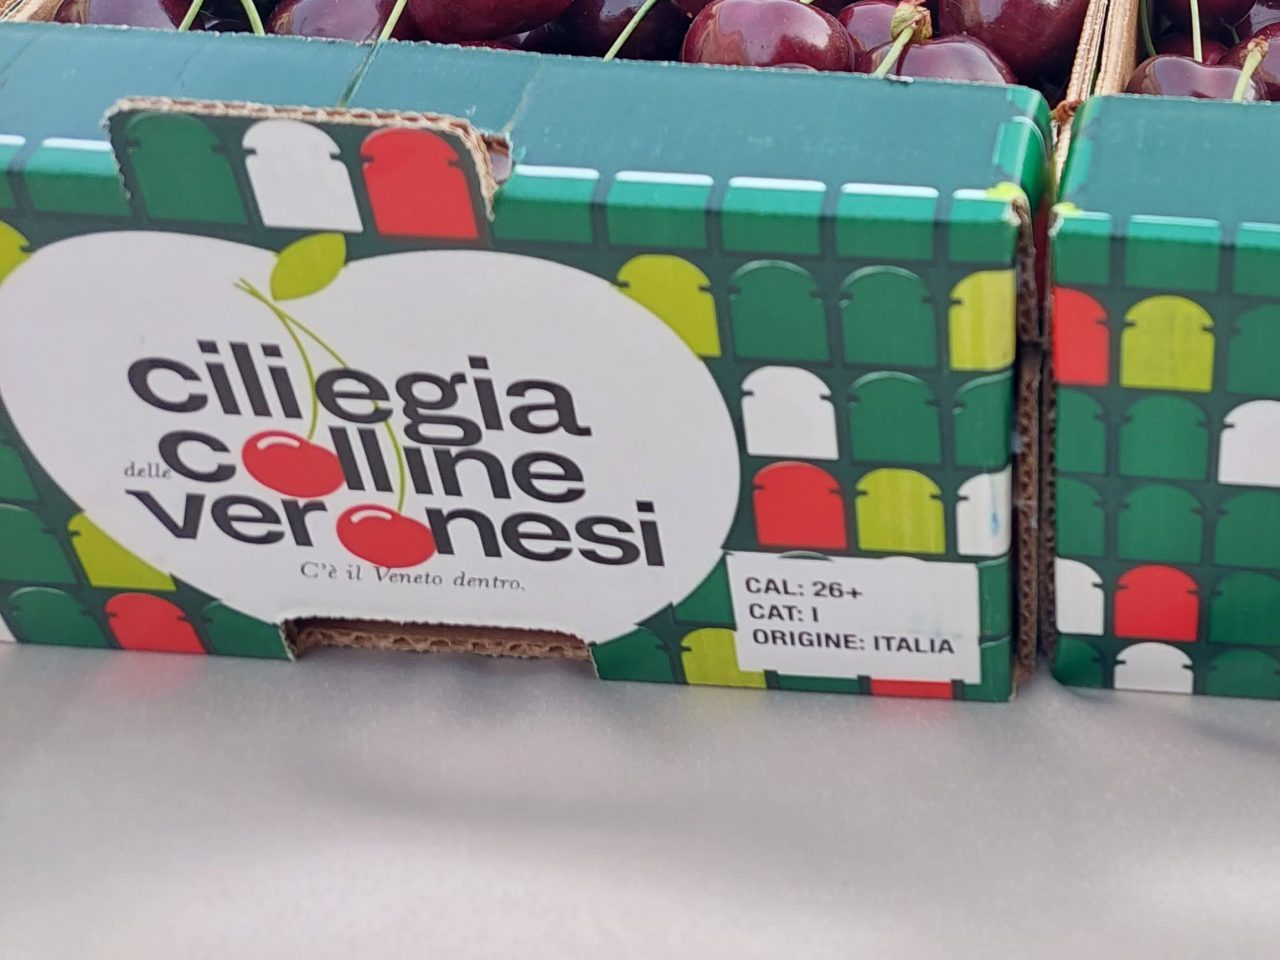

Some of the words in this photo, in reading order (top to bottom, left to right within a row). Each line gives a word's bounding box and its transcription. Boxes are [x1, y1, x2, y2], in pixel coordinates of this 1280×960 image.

[127, 339, 591, 446] ciliegia
[123, 462, 172, 480] delle
[346, 564, 363, 581] il
[374, 566, 444, 587] Veneto
[453, 571, 527, 592] dentro.
[745, 576, 804, 597] CAL:
[812, 580, 863, 599] 26+
[749, 603, 804, 622] CAT:
[753, 628, 865, 651] ORIGINE:
[874, 635, 955, 654] ITALIA
